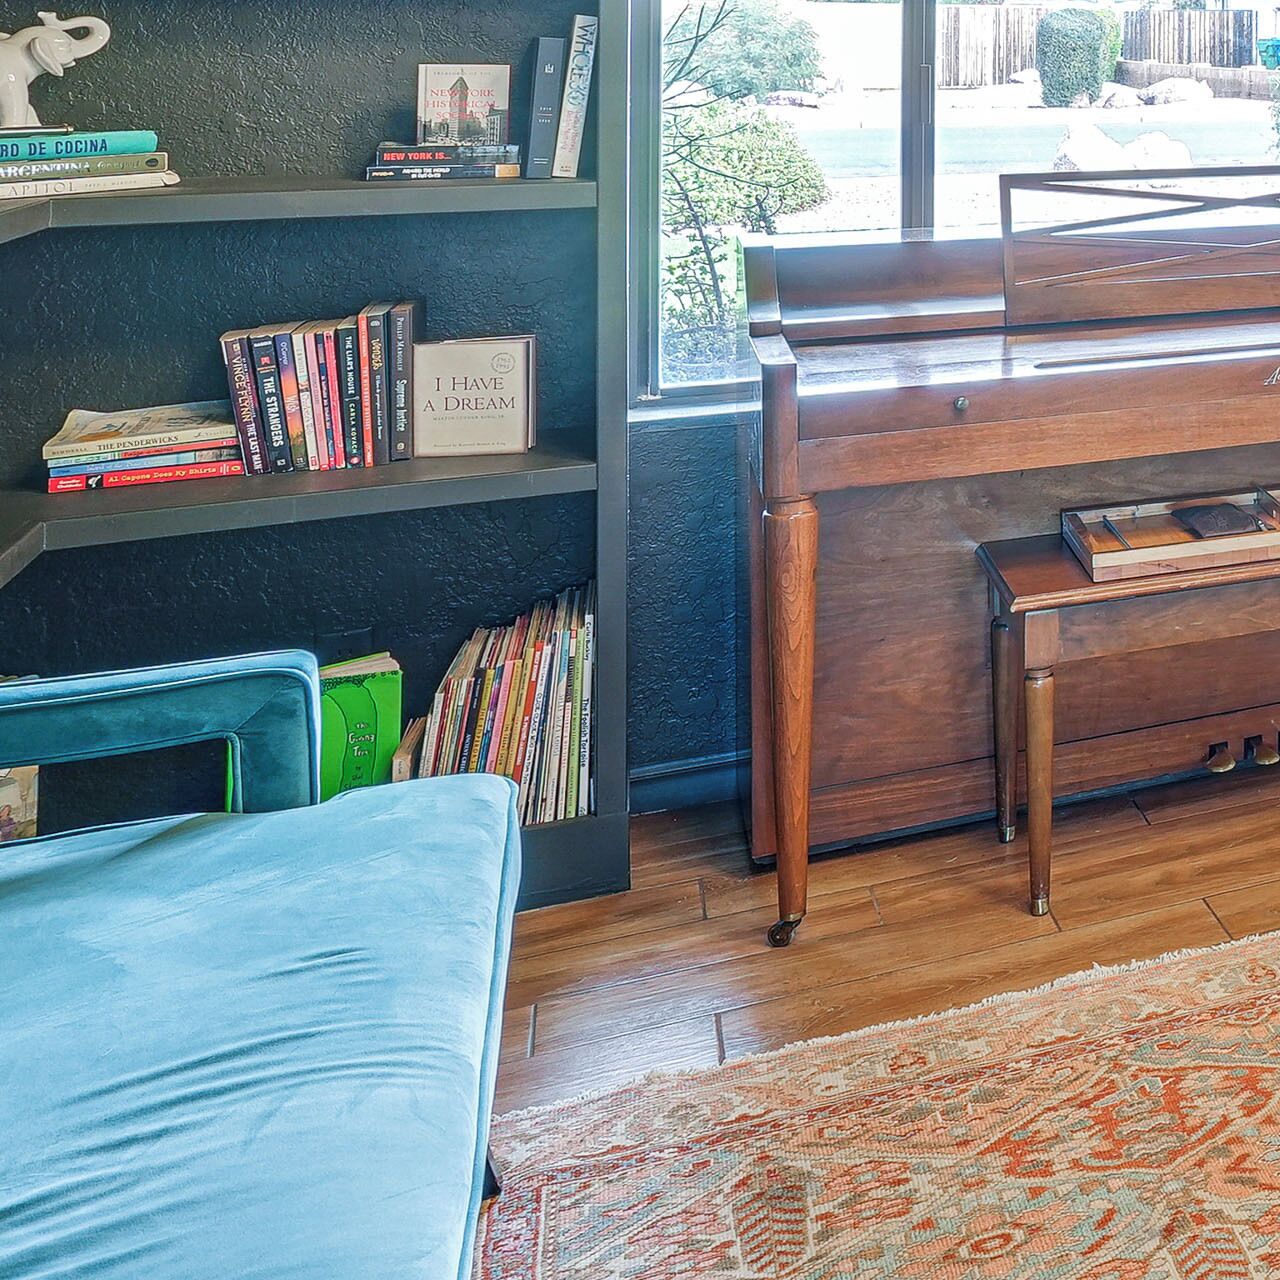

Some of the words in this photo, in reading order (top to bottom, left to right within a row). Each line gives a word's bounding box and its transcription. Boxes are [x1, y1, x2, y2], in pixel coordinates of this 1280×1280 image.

[430, 89, 459, 97] NEW
[461, 89, 495, 97] YORK
[425, 100, 499, 109] HISTORICAL
[28, 142, 46, 156] DE
[55, 138, 108, 155] COCINA
[383, 152, 405, 161] NEW
[407, 152, 433, 160] YORK
[0, 181, 77, 197] APITOL
[396, 317, 404, 339] PHILLIP
[344, 335, 352, 348] THE
[345, 349, 354, 370] LIAR'S
[396, 340, 404, 370] MARGOLIN
[232, 356, 246, 389] VINCE
[263, 376, 274, 394] THE
[435, 377, 441, 391] I
[452, 376, 504, 391] HAVE
[394, 380, 406, 407] Supreme
[238, 390, 250, 422] FLYNN
[423, 399, 435, 412] A
[444, 395, 515, 411] DREAM
[266, 396, 283, 447] STRANGERS
[348, 402, 356, 425] CARLA
[396, 409, 407, 431] Justice
[246, 422, 256, 437] THE
[97, 442, 115, 452] THE
[117, 435, 179, 450] PENDERWICKS
[249, 436, 258, 454] LAST
[350, 426, 358, 453] KOVACH
[252, 454, 262, 470] MAN
[121, 474, 151, 484] Capone
[188, 467, 217, 475] Shirts
[478, 707, 486, 722] THE
[580, 713, 589, 737] Foolish
[348, 732, 375, 744] Giving
[463, 733, 471, 756] ANCIENT
[579, 738, 588, 767] Tortoise
